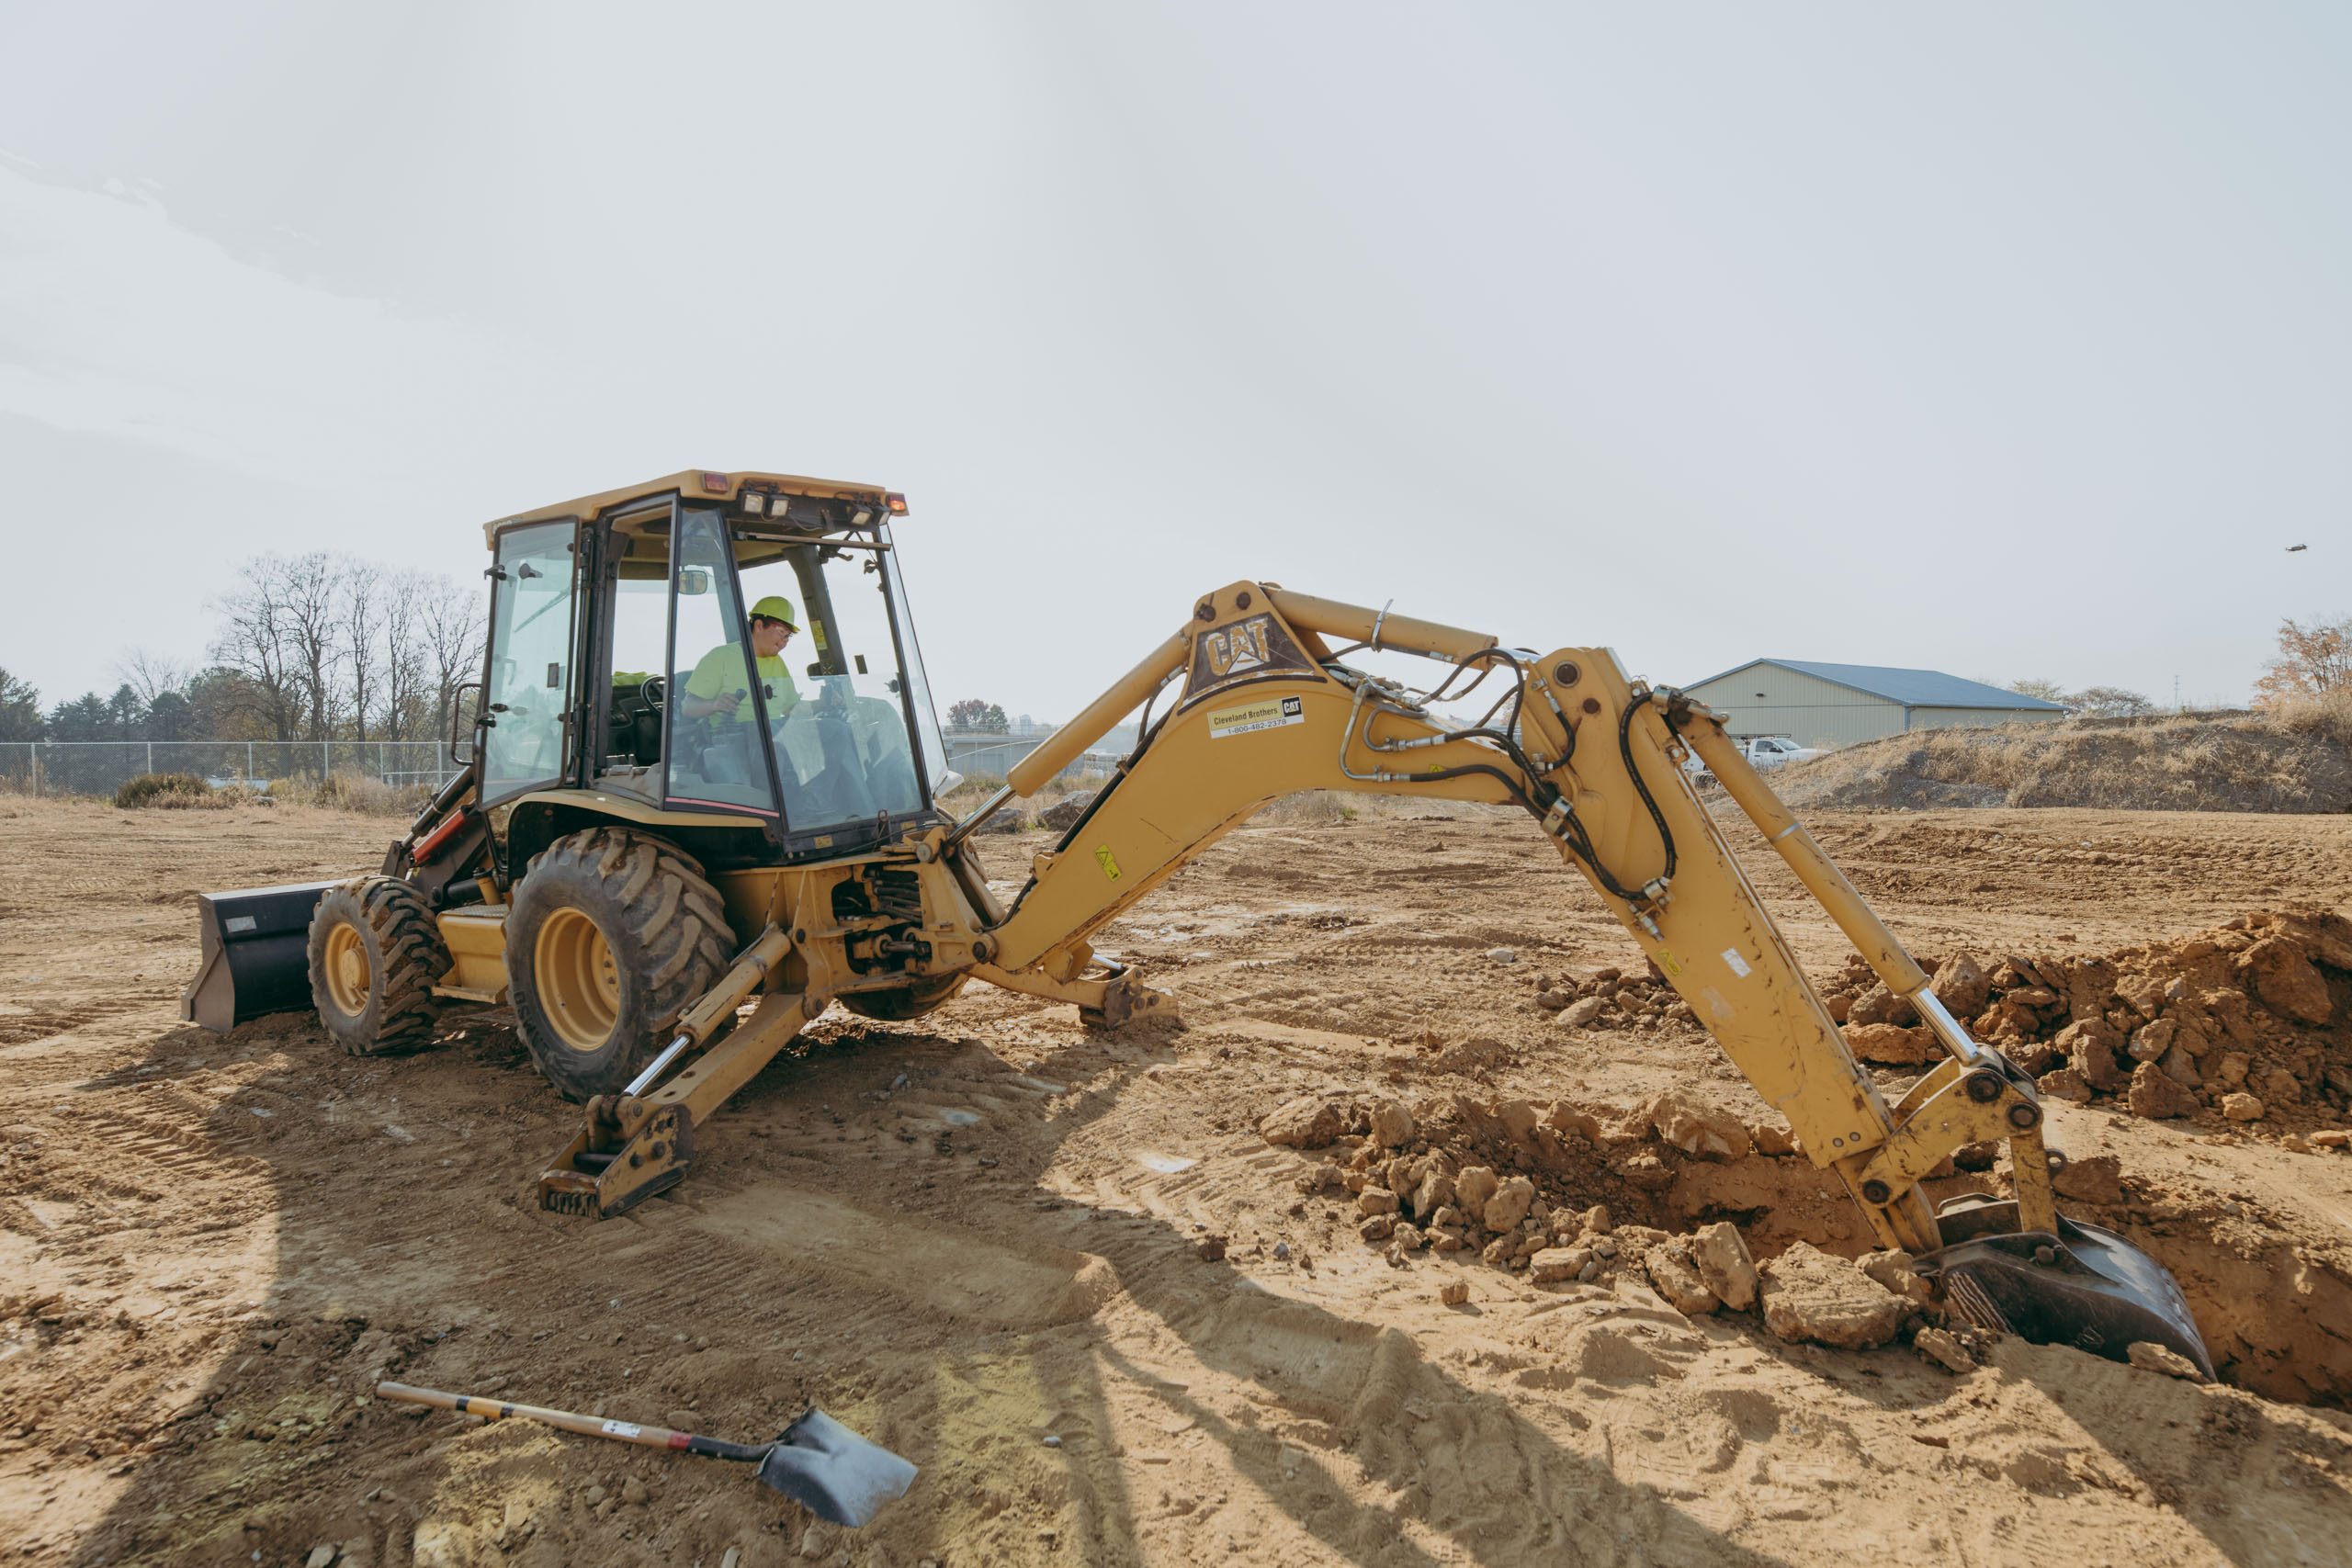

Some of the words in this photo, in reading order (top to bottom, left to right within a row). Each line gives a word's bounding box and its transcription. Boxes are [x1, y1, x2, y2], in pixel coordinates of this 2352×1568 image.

[1206, 618, 1271, 676] CAT
[1283, 700, 1300, 714] CAT
[1214, 712, 1247, 726] Cleveland
[1248, 707, 1278, 719] Brothers
[1227, 718, 1286, 735] 1-800-482-2378
